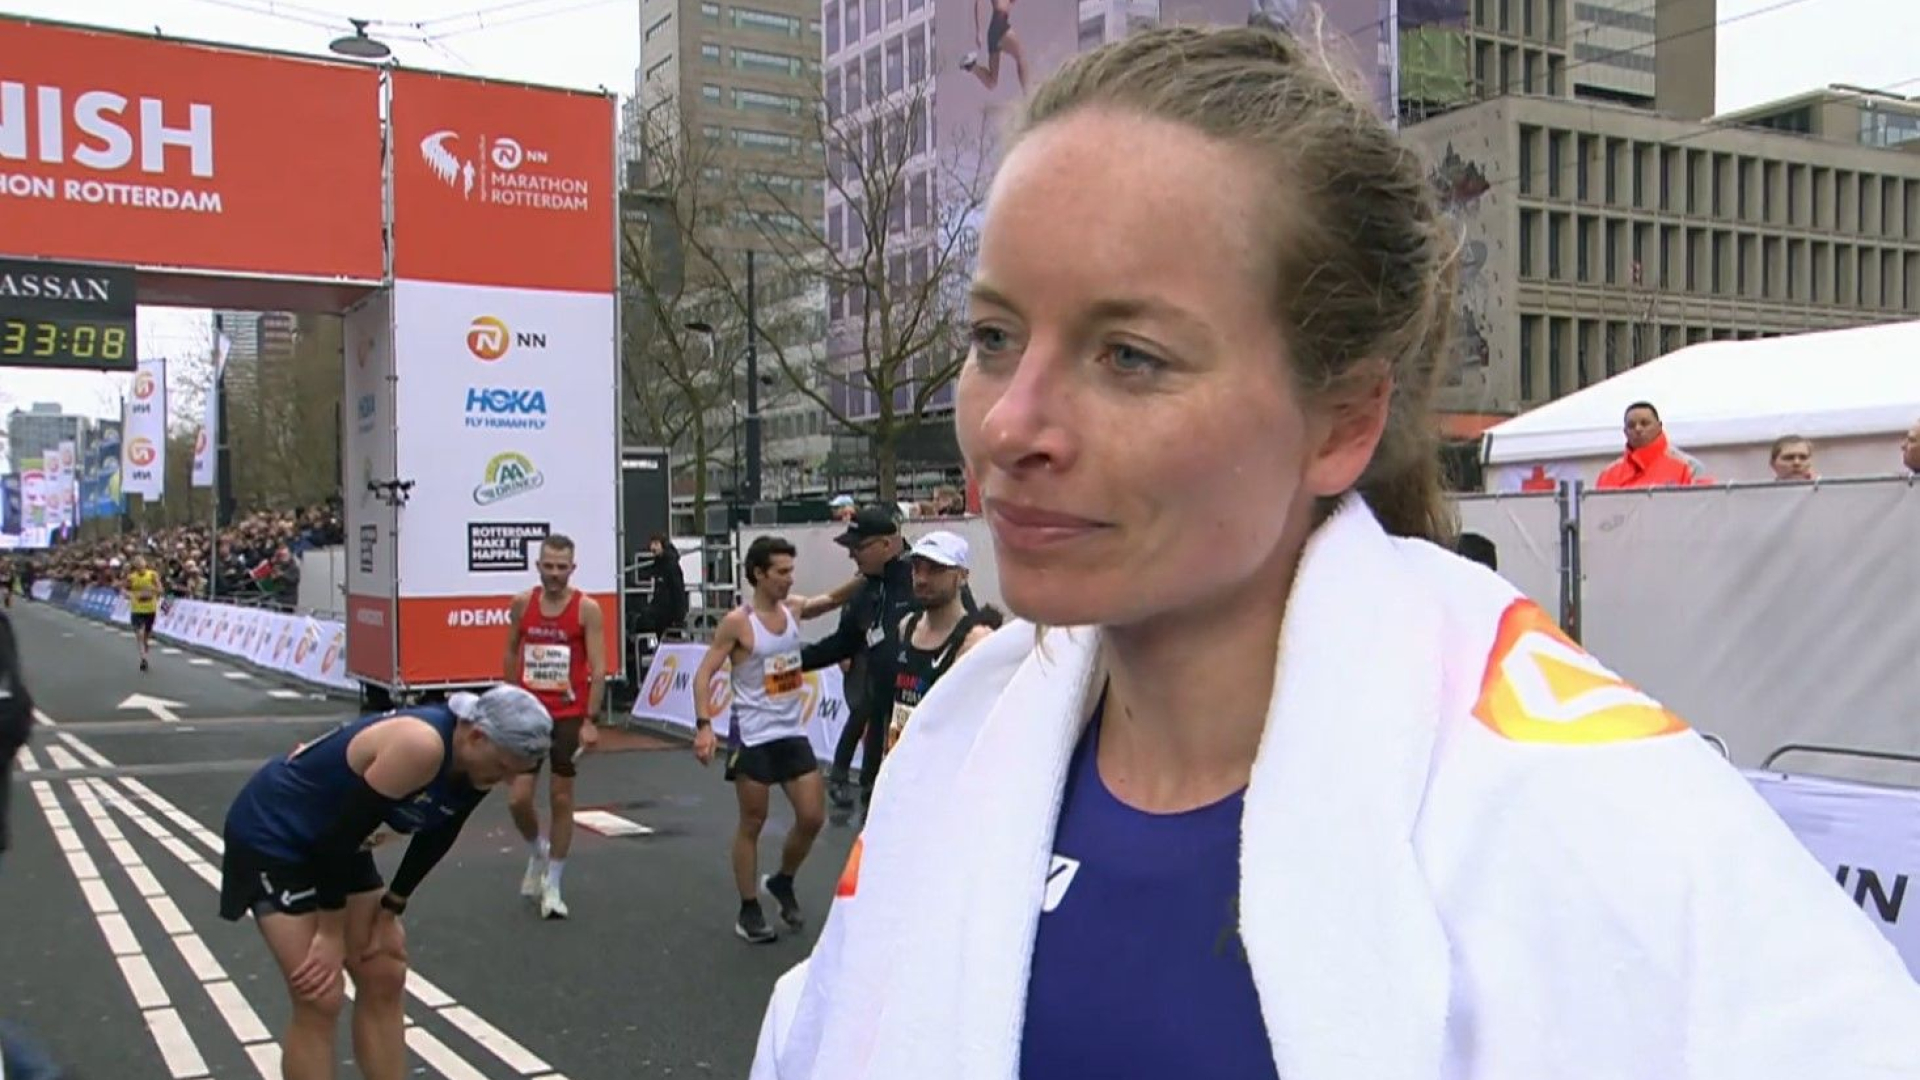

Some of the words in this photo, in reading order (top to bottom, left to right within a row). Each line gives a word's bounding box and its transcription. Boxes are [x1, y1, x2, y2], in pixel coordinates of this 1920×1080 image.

[527, 150, 548, 163] NN
[491, 171, 588, 194] MARATHON
[64, 178, 222, 213] ROTTERDAM
[491, 189, 588, 211] ROTTERDAM
[3, 321, 126, 359] 33:08
[517, 332, 546, 348] NN
[465, 387, 546, 414] HOKA
[465, 416, 482, 428] FLY
[485, 417, 527, 429] HUMAN
[529, 419, 546, 430] FLY
[500, 464, 525, 482] AA
[472, 538, 506, 549] MAKE
[510, 538, 521, 548] IT
[472, 549, 525, 561] HAPPEN.
